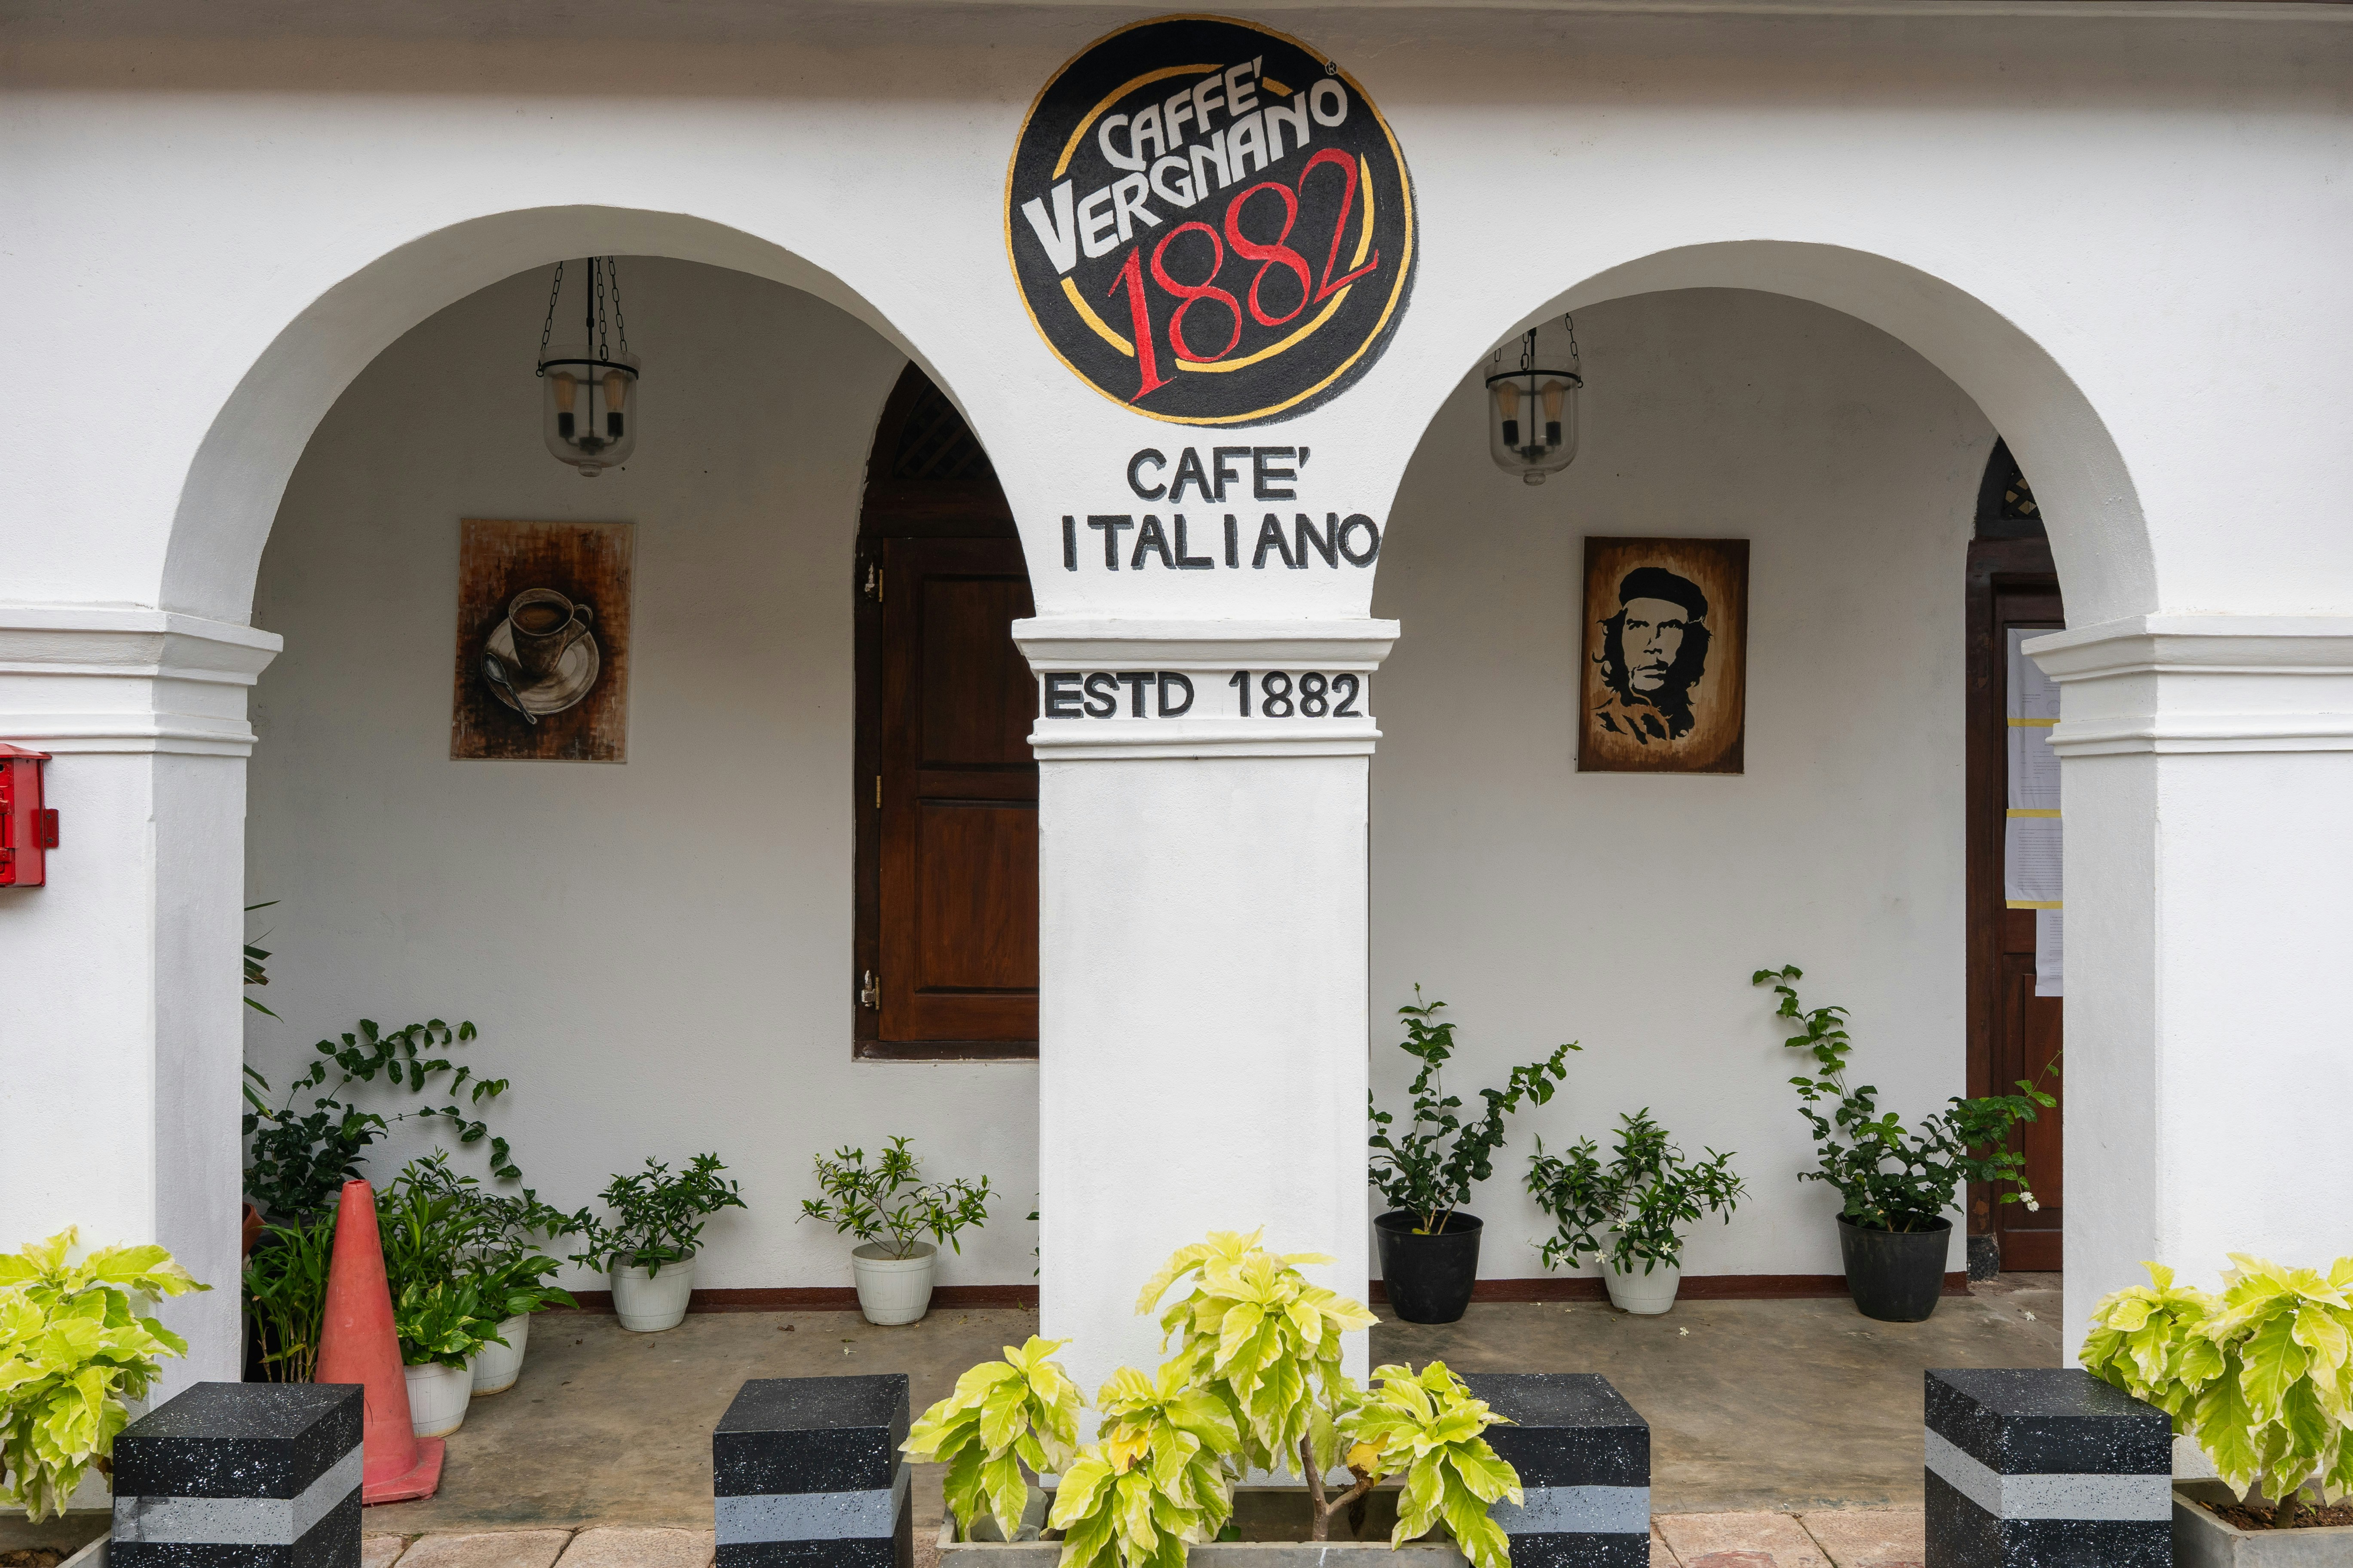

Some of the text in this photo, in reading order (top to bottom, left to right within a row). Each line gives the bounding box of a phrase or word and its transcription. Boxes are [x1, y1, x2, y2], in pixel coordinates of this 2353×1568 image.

[1022, 79, 1348, 274] VERGNANO
[1108, 147, 1378, 404] 1882
[1062, 512, 1381, 571] ITALIANO
[1045, 670, 1361, 718] ESTD 1882
